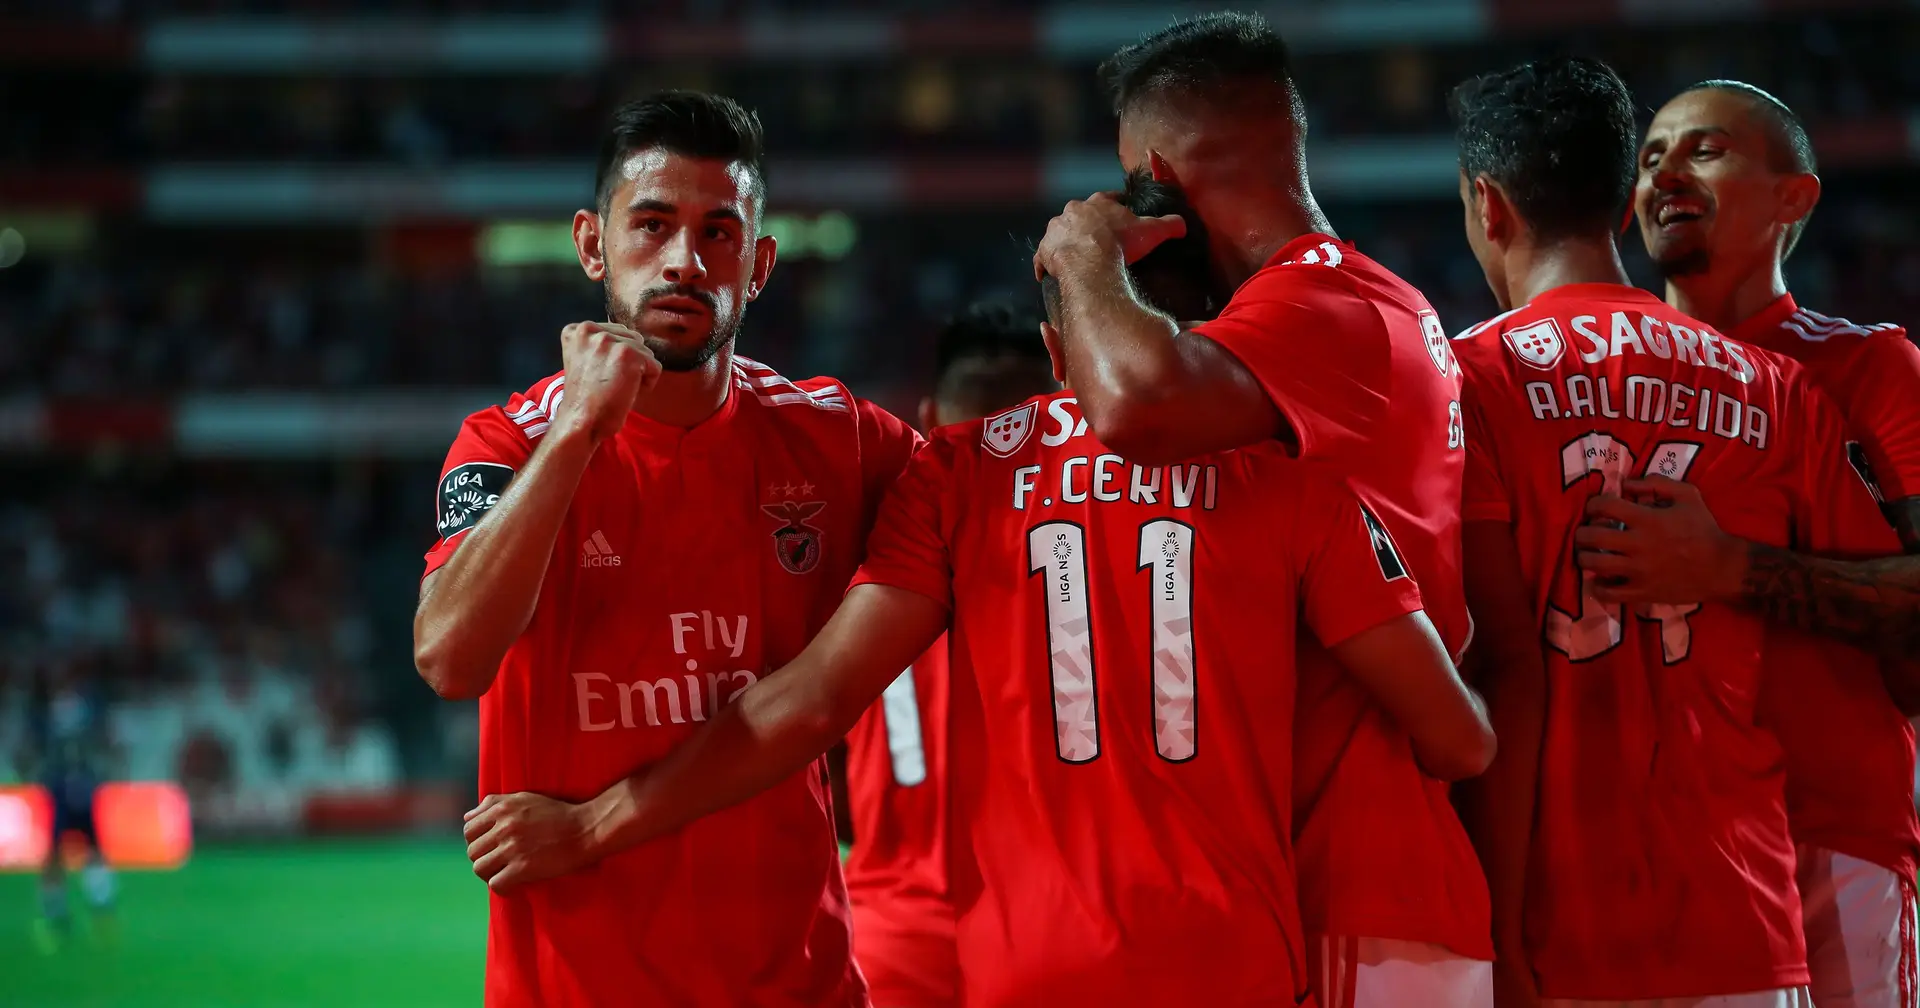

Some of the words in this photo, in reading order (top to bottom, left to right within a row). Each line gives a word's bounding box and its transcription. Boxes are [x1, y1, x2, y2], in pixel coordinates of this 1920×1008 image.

[1570, 311, 1756, 384] SAGRES
[445, 472, 484, 494] LIGA
[1060, 573, 1071, 602] LIGA
[1165, 572, 1175, 601] LIGA
[669, 610, 748, 658] Fly
[1026, 516, 1198, 765] 11
